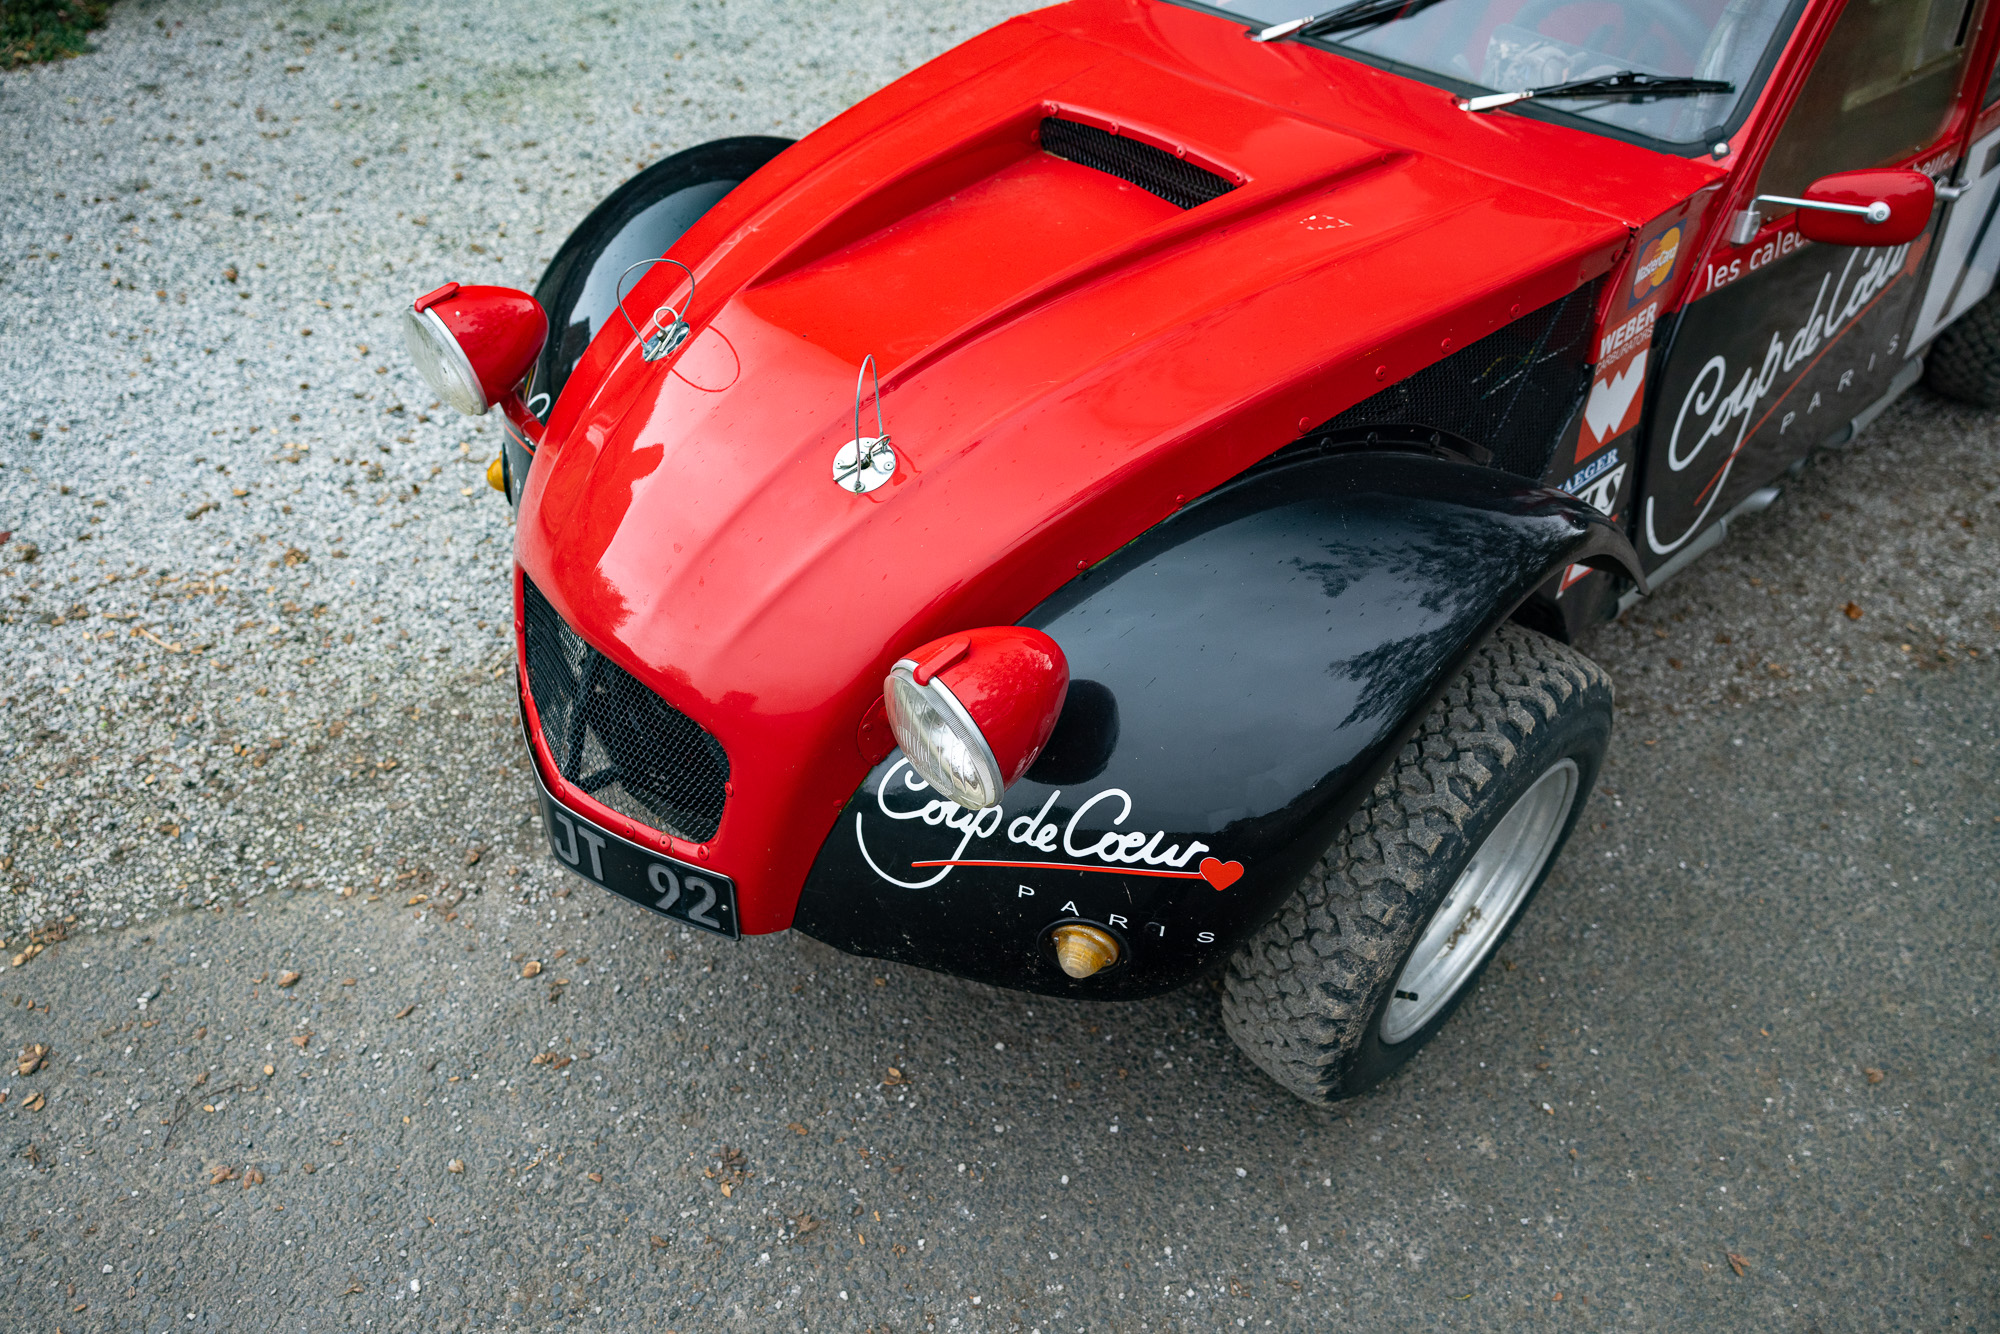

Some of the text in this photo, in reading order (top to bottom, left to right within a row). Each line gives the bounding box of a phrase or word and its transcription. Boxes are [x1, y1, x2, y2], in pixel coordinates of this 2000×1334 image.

[1634, 242, 1679, 286] MasterCard
[1706, 258, 1741, 292] les
[1600, 302, 1657, 359] WEBER
[1645, 331, 1784, 555] Coup
[1783, 271, 1831, 373] de
[1780, 333, 1899, 434] PARIS
[856, 757, 1003, 889] Coup
[1007, 789, 1067, 852] de
[554, 811, 720, 929] JT 92
[1018, 884, 1215, 943] PARIS
